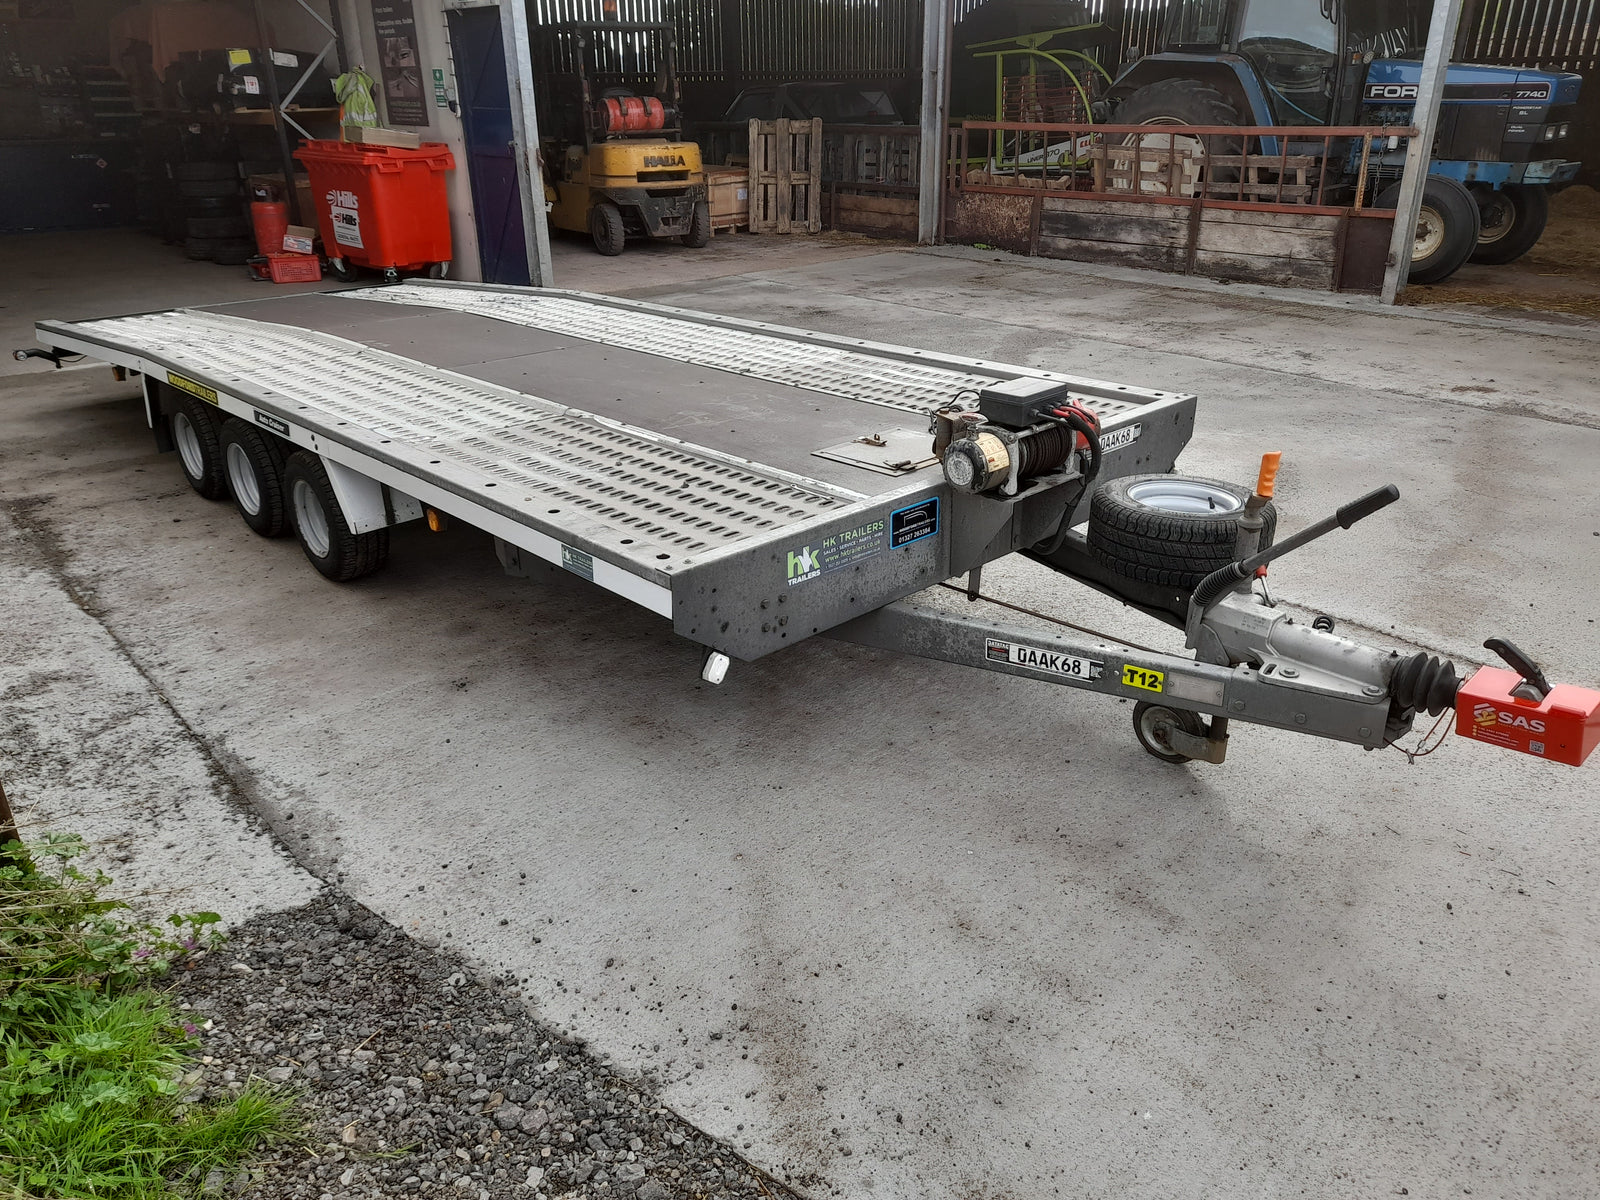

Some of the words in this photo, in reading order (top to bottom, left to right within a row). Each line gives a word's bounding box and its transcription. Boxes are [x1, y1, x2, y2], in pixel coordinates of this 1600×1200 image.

[1370, 85, 1418, 98] FOR
[1516, 90, 1547, 98] 7740
[336, 190, 359, 209] Hills
[341, 213, 357, 226] Hills
[823, 536, 837, 549] HK
[839, 520, 885, 542] TRAILERS
[823, 547, 837, 556] SALES
[839, 540, 857, 549] SERVICE
[824, 539, 881, 563] www.hktrailers.co.uk
[787, 569, 821, 586] TRAILERS
[1126, 669, 1159, 688] T12
[1497, 711, 1546, 733] SAS
